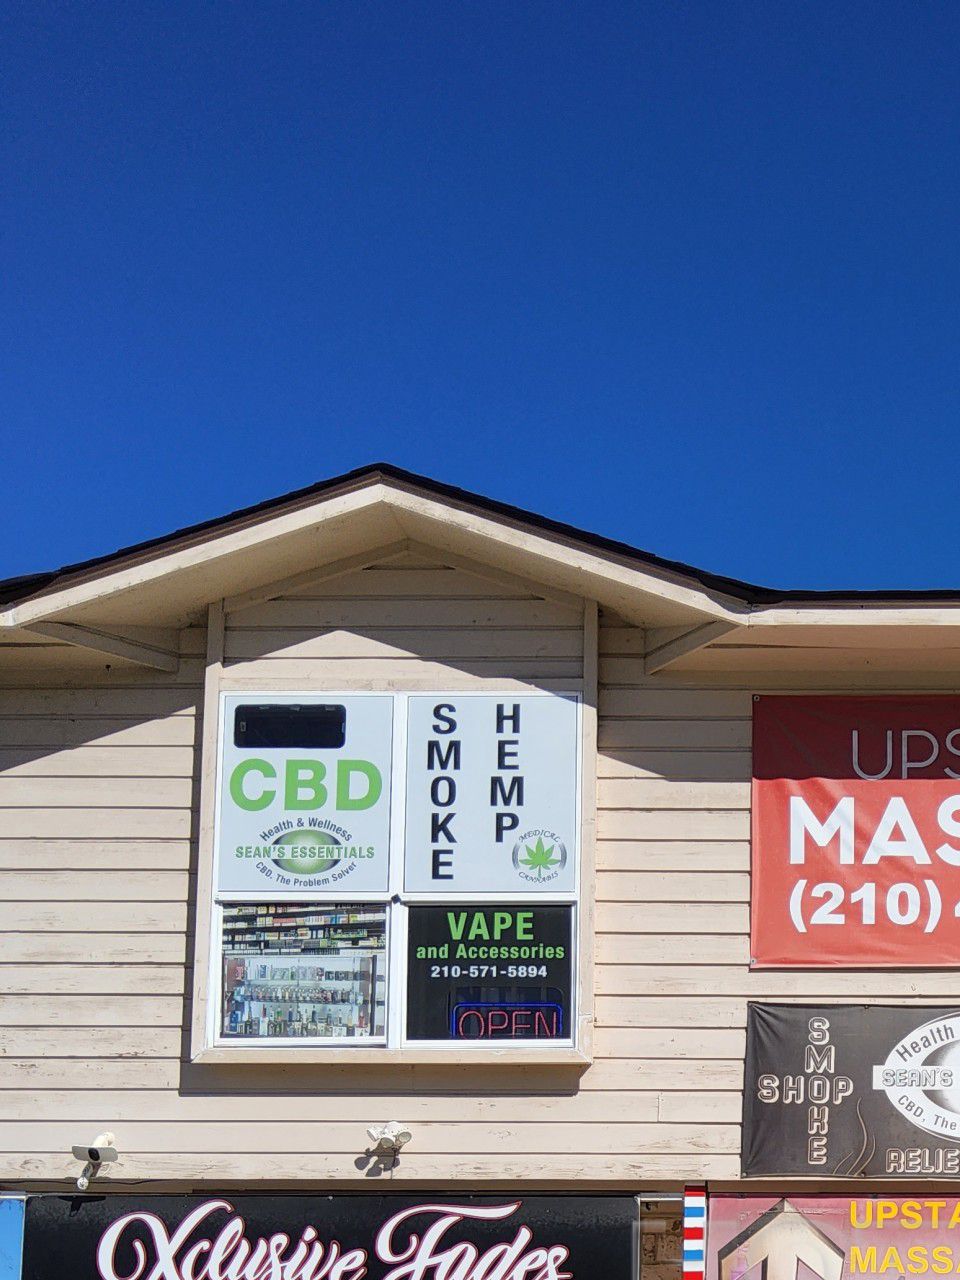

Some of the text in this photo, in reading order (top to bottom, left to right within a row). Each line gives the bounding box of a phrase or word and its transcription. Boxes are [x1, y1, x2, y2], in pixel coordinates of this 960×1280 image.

[229, 757, 383, 812] CBD
[490, 703, 524, 843] HEMP
[426, 703, 462, 881] SMOKE
[259, 816, 353, 842] Health & Wellness
[518, 829, 561, 843] MEDICAL
[235, 845, 375, 859] SEAN'S ESSENTIALS
[276, 873, 291, 886] The
[293, 876, 330, 888] Problem
[332, 861, 357, 882] Solver
[518, 871, 559, 884] CANNABIS
[789, 879, 943, 934] (210)
[447, 911, 534, 941] VAPE
[416, 943, 565, 960] and Accessories
[430, 965, 548, 979] 210-571-5894
[459, 1010, 557, 1040] OPEN
[896, 1024, 955, 1063] Health
[757, 1074, 854, 1105] SHOP
[805, 1016, 836, 1165] SMOKE
[882, 1069, 954, 1088] SEAN'S
[897, 1094, 926, 1123] CBD,
[933, 1114, 957, 1132] The
